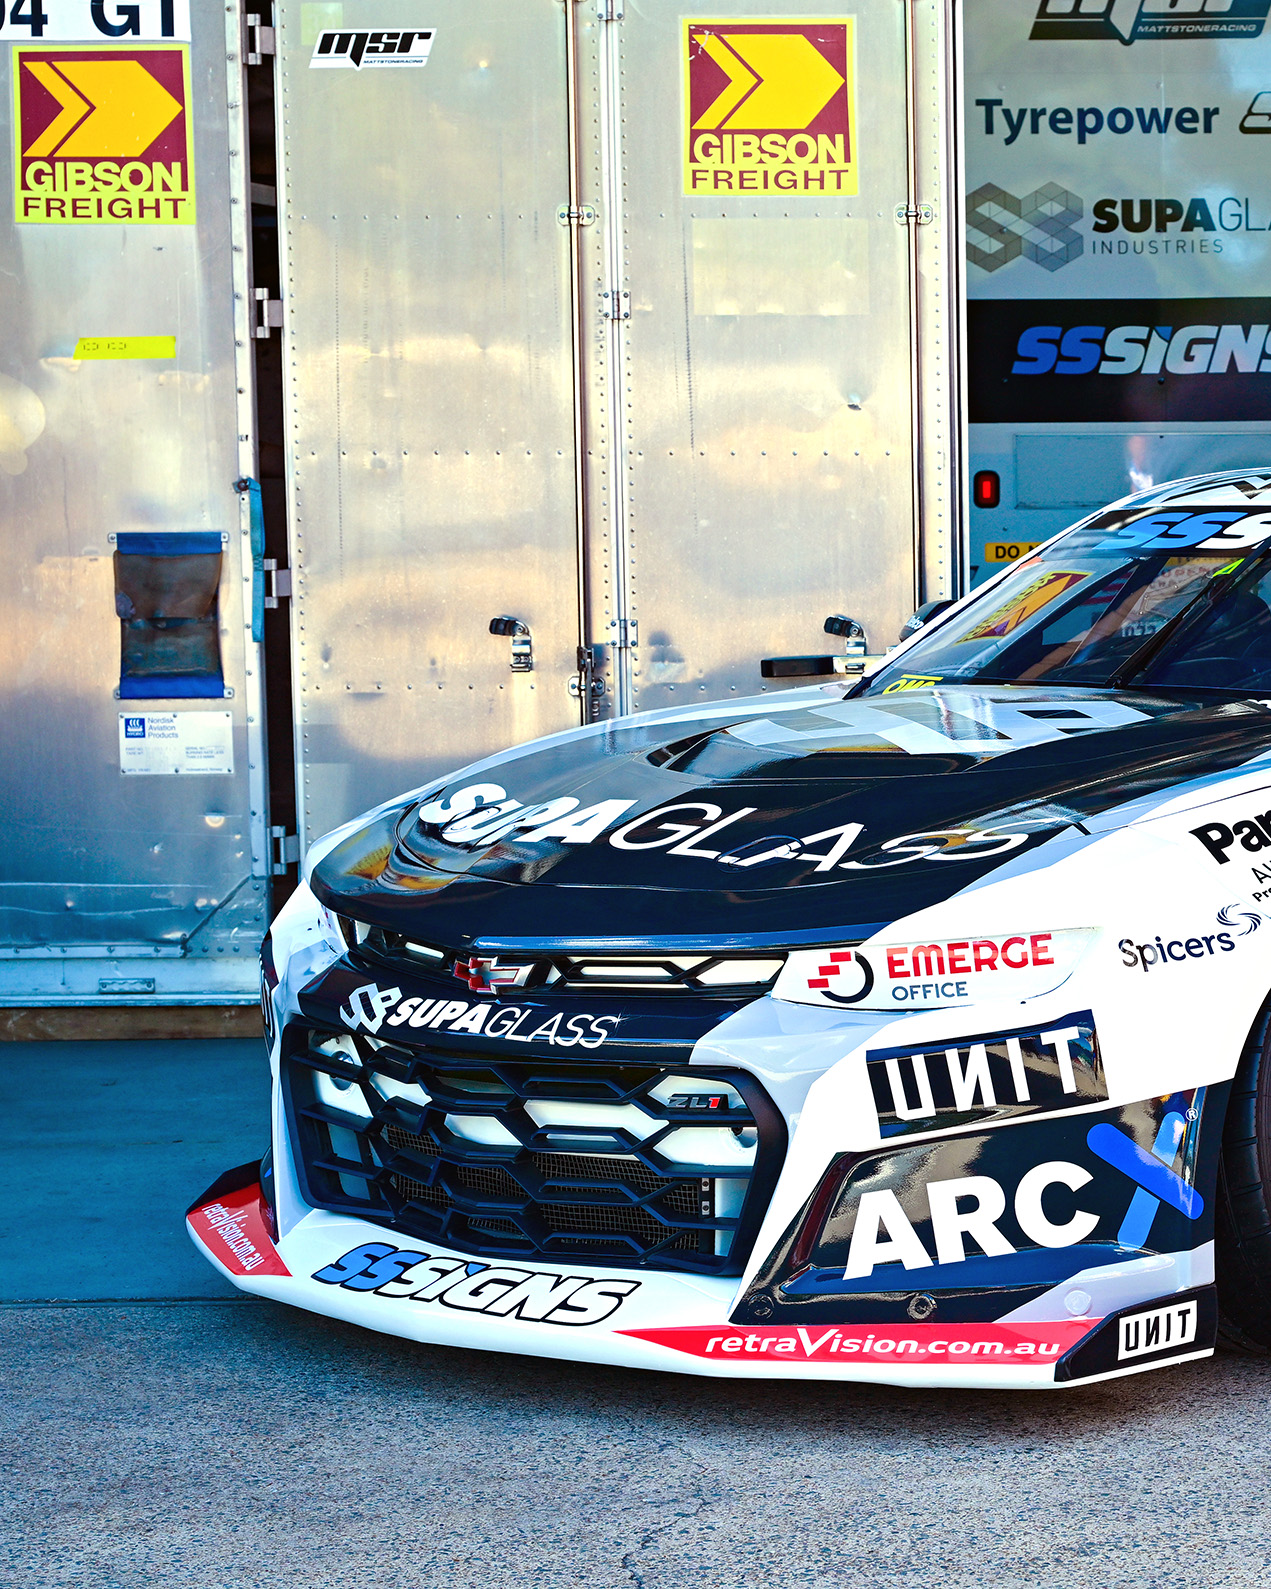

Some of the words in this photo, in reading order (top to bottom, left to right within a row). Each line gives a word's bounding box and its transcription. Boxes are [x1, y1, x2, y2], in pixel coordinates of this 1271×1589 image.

[1137, 24, 1258, 33] MATTSTONERACING
[975, 98, 1220, 146] Tyrepower
[694, 134, 844, 164] GIBSON
[24, 161, 182, 193] GIBSON
[691, 169, 849, 190] FREIGHT
[22, 197, 187, 219] FREIGHT
[1092, 239, 1224, 255] INDUSTRIES
[996, 545, 1019, 559] DO
[887, 933, 1055, 979] EMERGE
[1119, 931, 1236, 972] Spicers
[891, 980, 968, 1000] OFFICE
[388, 997, 623, 1049] SUPAGLASS
[886, 1025, 1081, 1121] UNIT
[667, 1094, 729, 1110] ZL1
[202, 1203, 265, 1271] retraVision.com.au
[705, 1327, 1066, 1358] retraVision.com.au
[1125, 1308, 1192, 1353] UNIT
